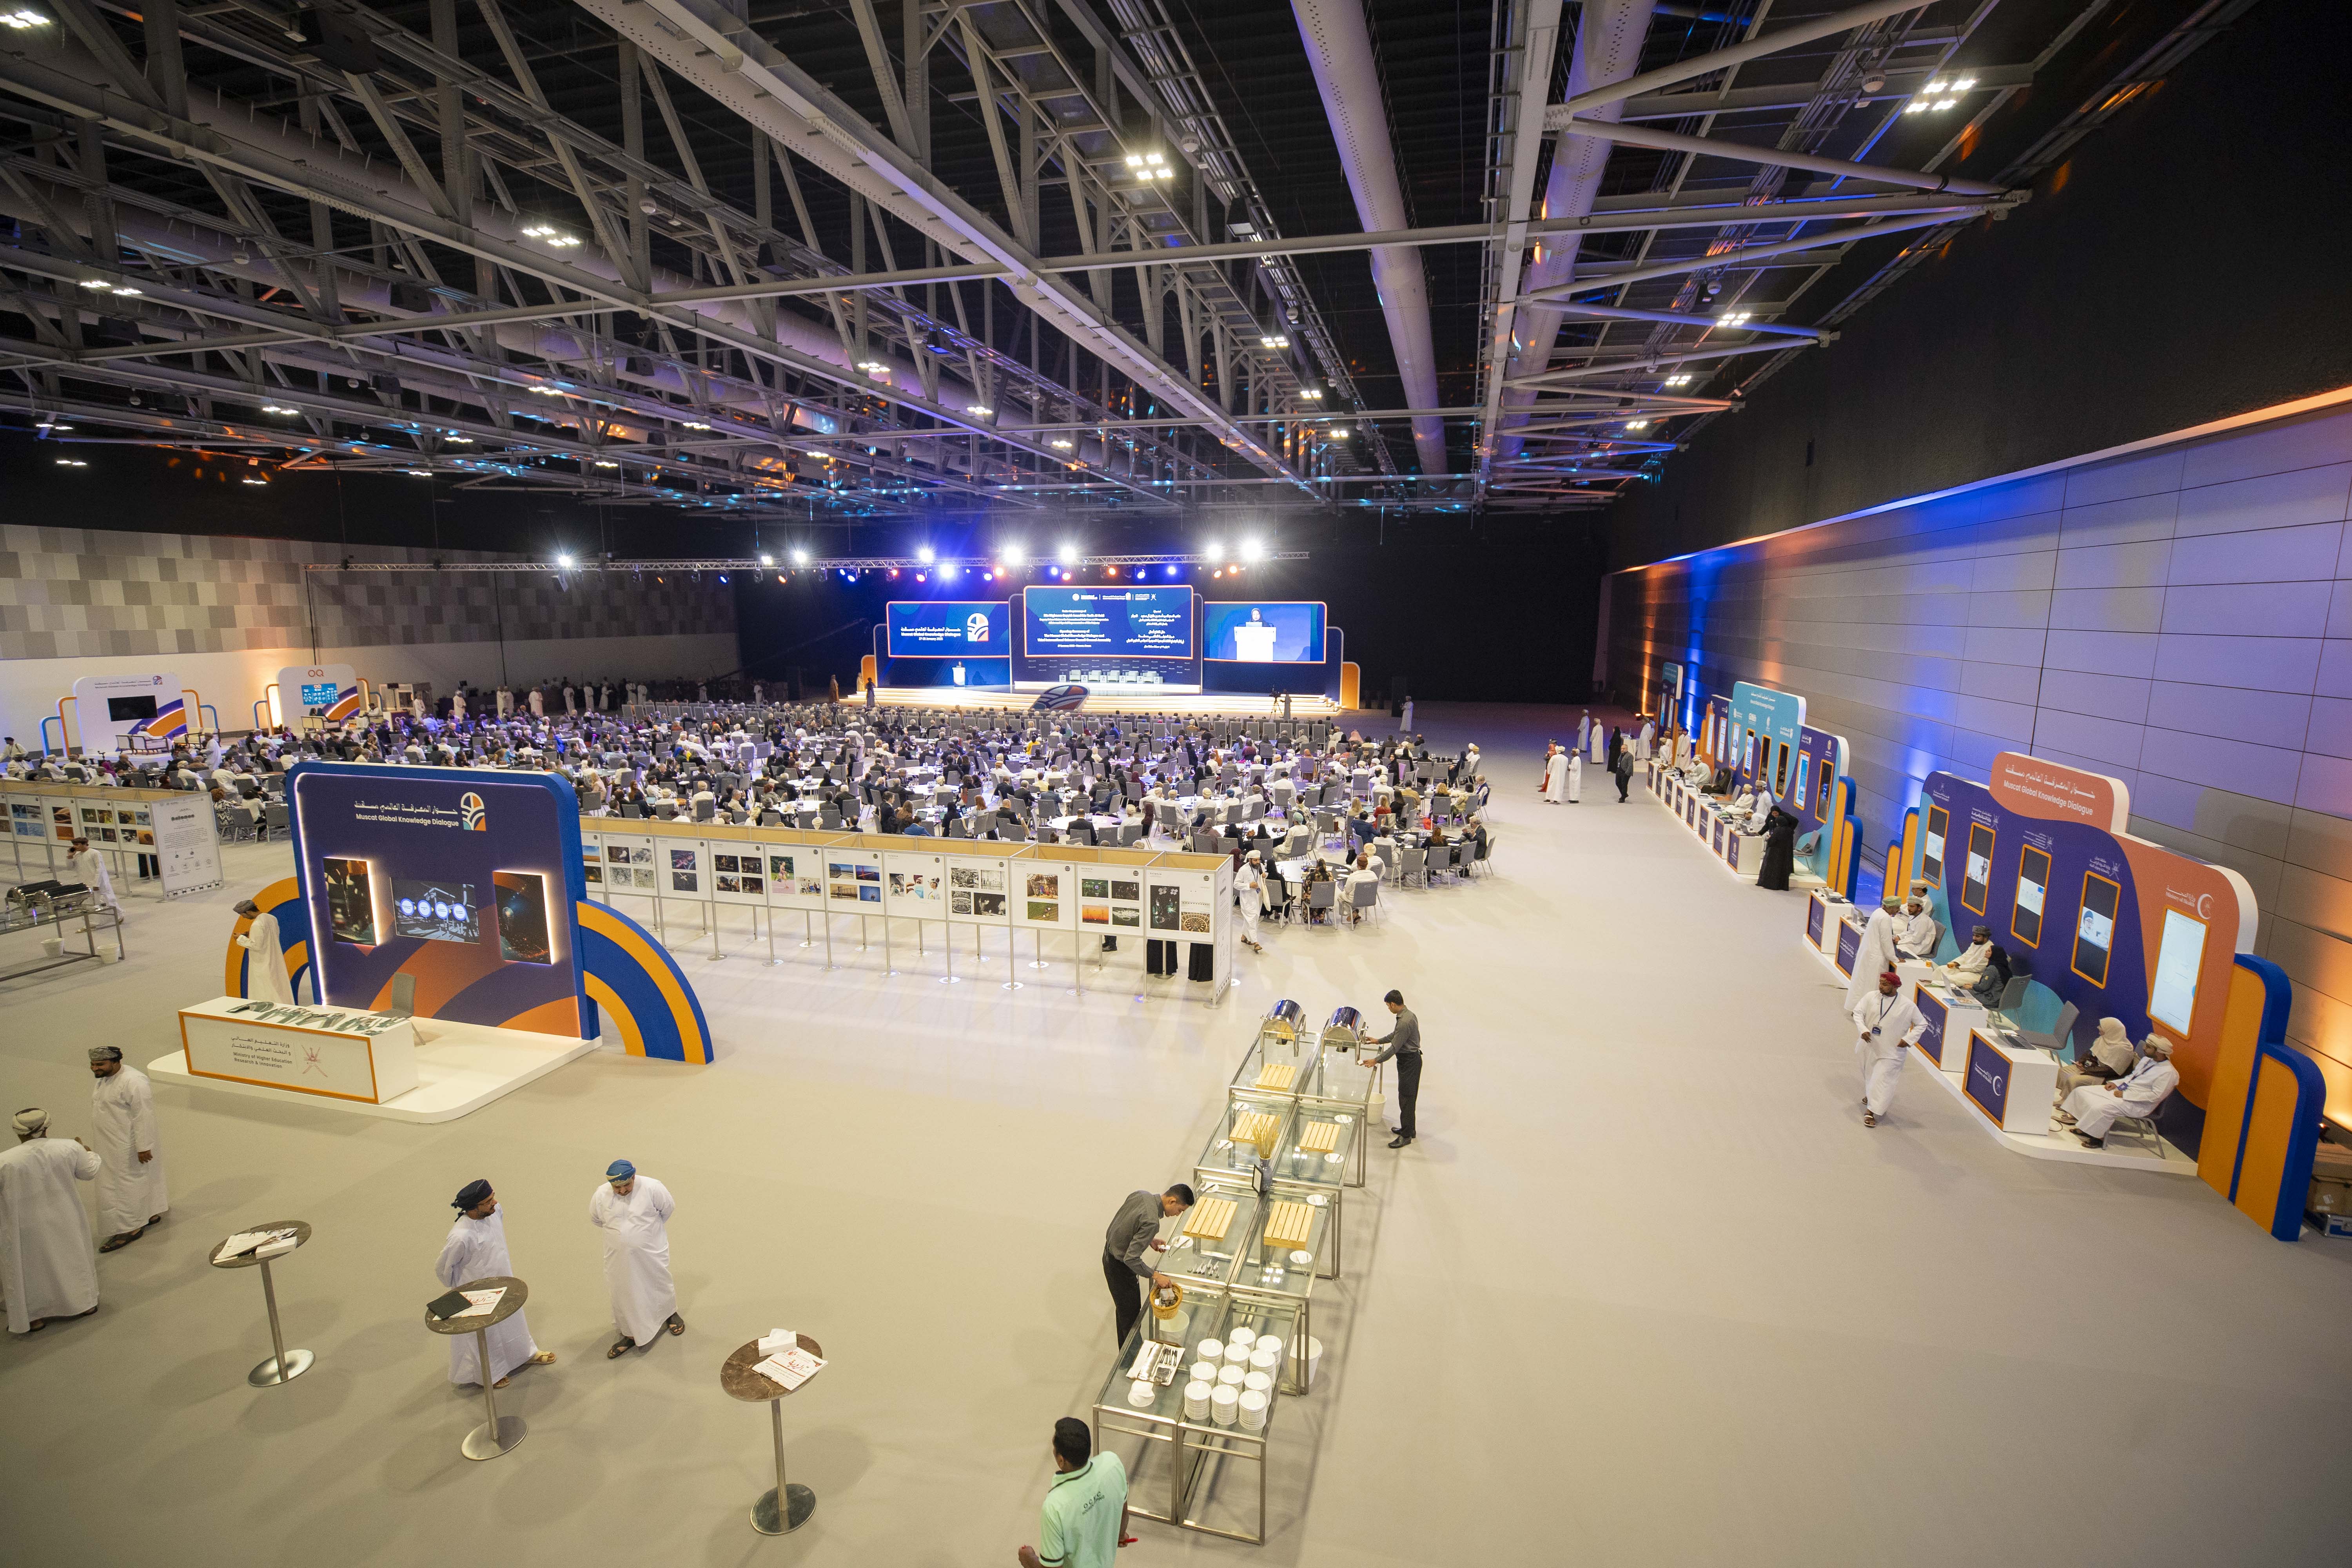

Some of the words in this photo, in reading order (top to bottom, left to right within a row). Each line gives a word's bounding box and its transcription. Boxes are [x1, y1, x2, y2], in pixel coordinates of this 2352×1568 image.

[2005, 764, 2025, 777] مسقط
[2025, 771, 2044, 783] العالمي
[2044, 775, 2070, 790] المعرفة
[2070, 783, 2095, 799] حوار
[2004, 780, 2021, 792] Muscat
[2022, 786, 2037, 797] Global
[2038, 791, 2067, 808] Knowledge
[2067, 800, 2093, 815] Dialogue
[354, 800, 379, 809] مسقط
[380, 803, 400, 812] العالمي
[401, 804, 431, 813] المعرفة
[432, 806, 458, 815] حوار
[398, 816, 431, 826] Knowledge
[432, 818, 459, 828] Dialogue
[2165, 891, 2179, 902] Ministry
[2183, 898, 2195, 907] Health
